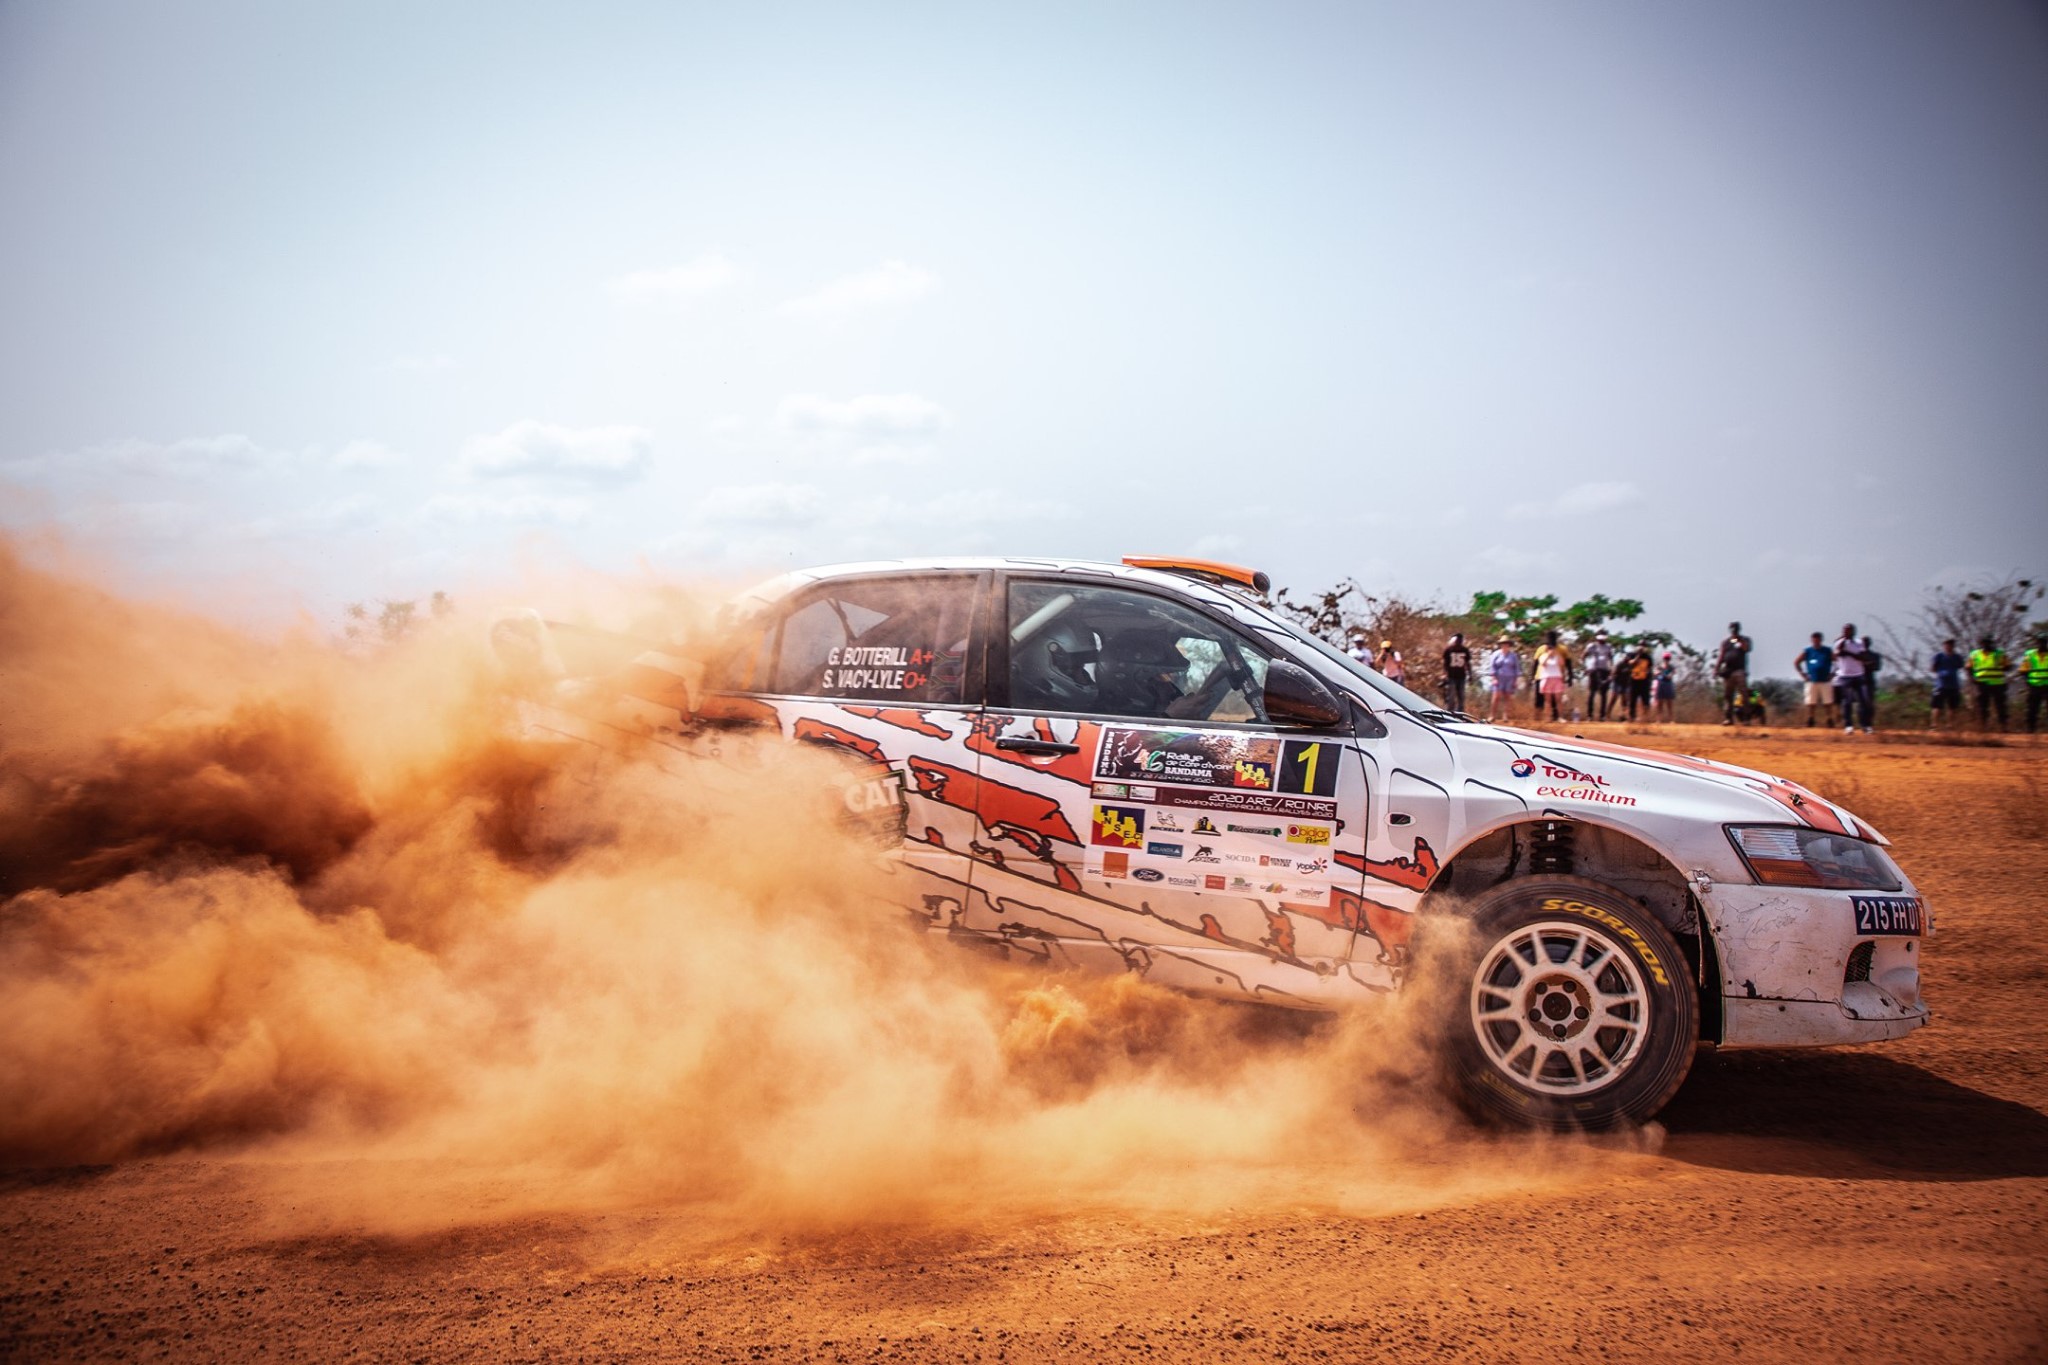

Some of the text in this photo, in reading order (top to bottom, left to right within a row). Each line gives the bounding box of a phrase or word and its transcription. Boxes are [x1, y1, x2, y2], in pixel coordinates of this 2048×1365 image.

[828, 647, 934, 666] G. BOTTERILL A+
[1450, 652, 1467, 667] 15
[822, 669, 927, 689] S. VACY-LYLE O+
[1166, 752, 1204, 763] Rallye
[1164, 765, 1213, 778] BANDAMA
[1298, 743, 1320, 794] 1
[1541, 765, 1610, 786] TOTAL
[844, 776, 900, 813] CAT
[1208, 793, 1244, 804] 2020
[1246, 796, 1273, 807] ARC
[1307, 802, 1334, 812] NRC
[1537, 785, 1637, 806] excellium
[1138, 869, 1160, 881] Ford
[1858, 900, 1889, 930] 215
[1890, 901, 1908, 930] FH
[1541, 899, 1670, 986] SCORPION
